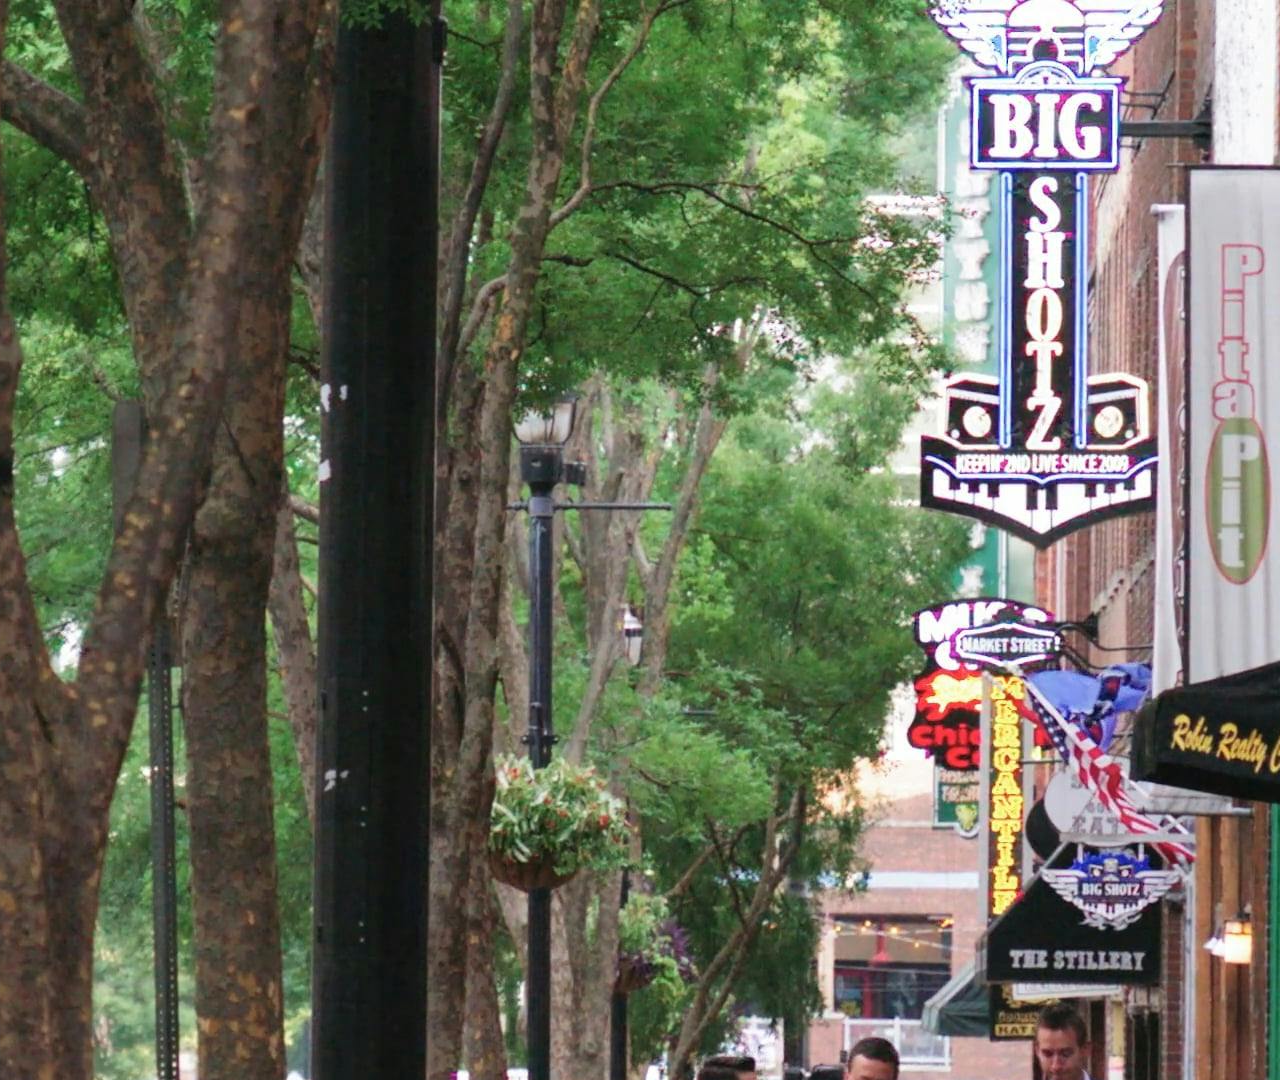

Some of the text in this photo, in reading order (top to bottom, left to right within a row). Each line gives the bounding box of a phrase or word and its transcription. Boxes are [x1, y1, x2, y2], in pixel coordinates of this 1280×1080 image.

[988, 92, 1102, 159] BIG
[1024, 176, 1065, 450] SHOTZ
[1061, 454, 1097, 473] SINCE
[962, 636, 1053, 653] MARKET STREET
[1171, 714, 1214, 754] Robin
[1216, 722, 1268, 774] Realty
[1081, 883, 1141, 897] BIG SHOTZ
[1009, 949, 1146, 971] THE STILLERY
